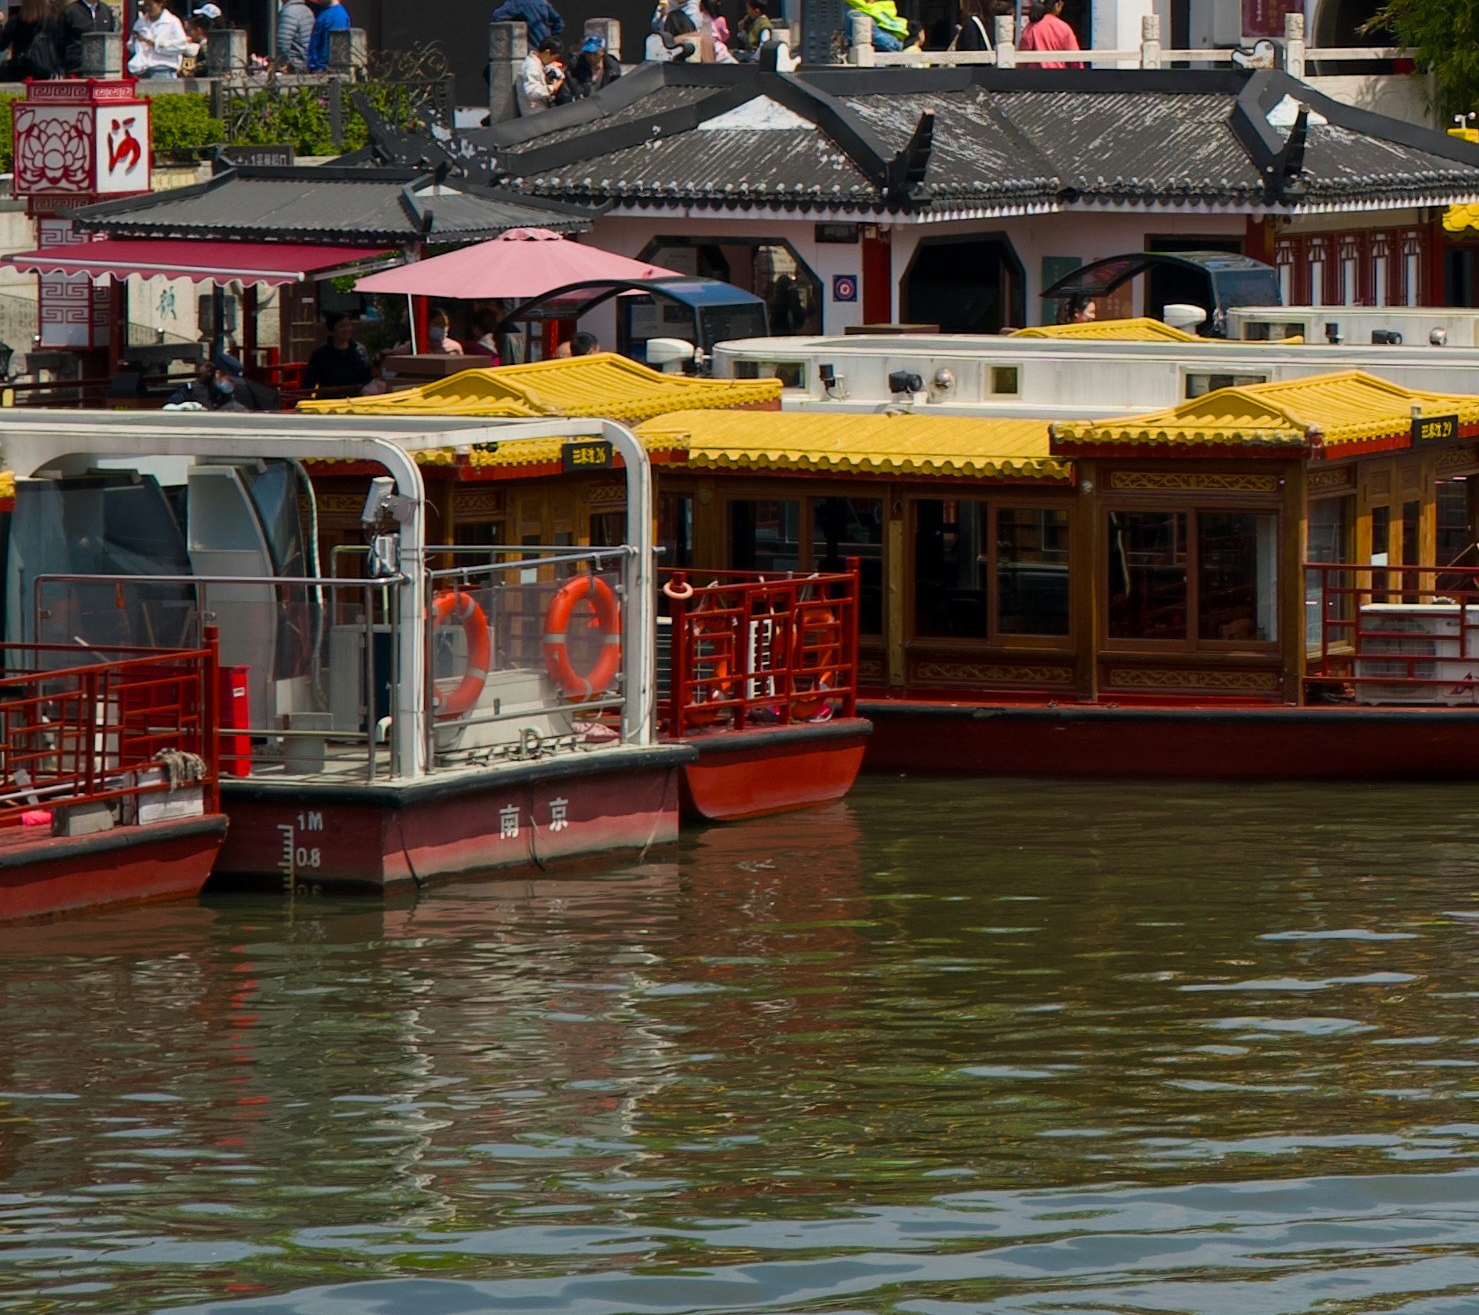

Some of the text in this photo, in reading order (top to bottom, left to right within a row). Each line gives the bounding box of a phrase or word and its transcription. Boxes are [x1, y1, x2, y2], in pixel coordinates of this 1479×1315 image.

[297, 811, 323, 831] 1M
[499, 797, 570, 839] 南京
[296, 847, 321, 868] 0.8
